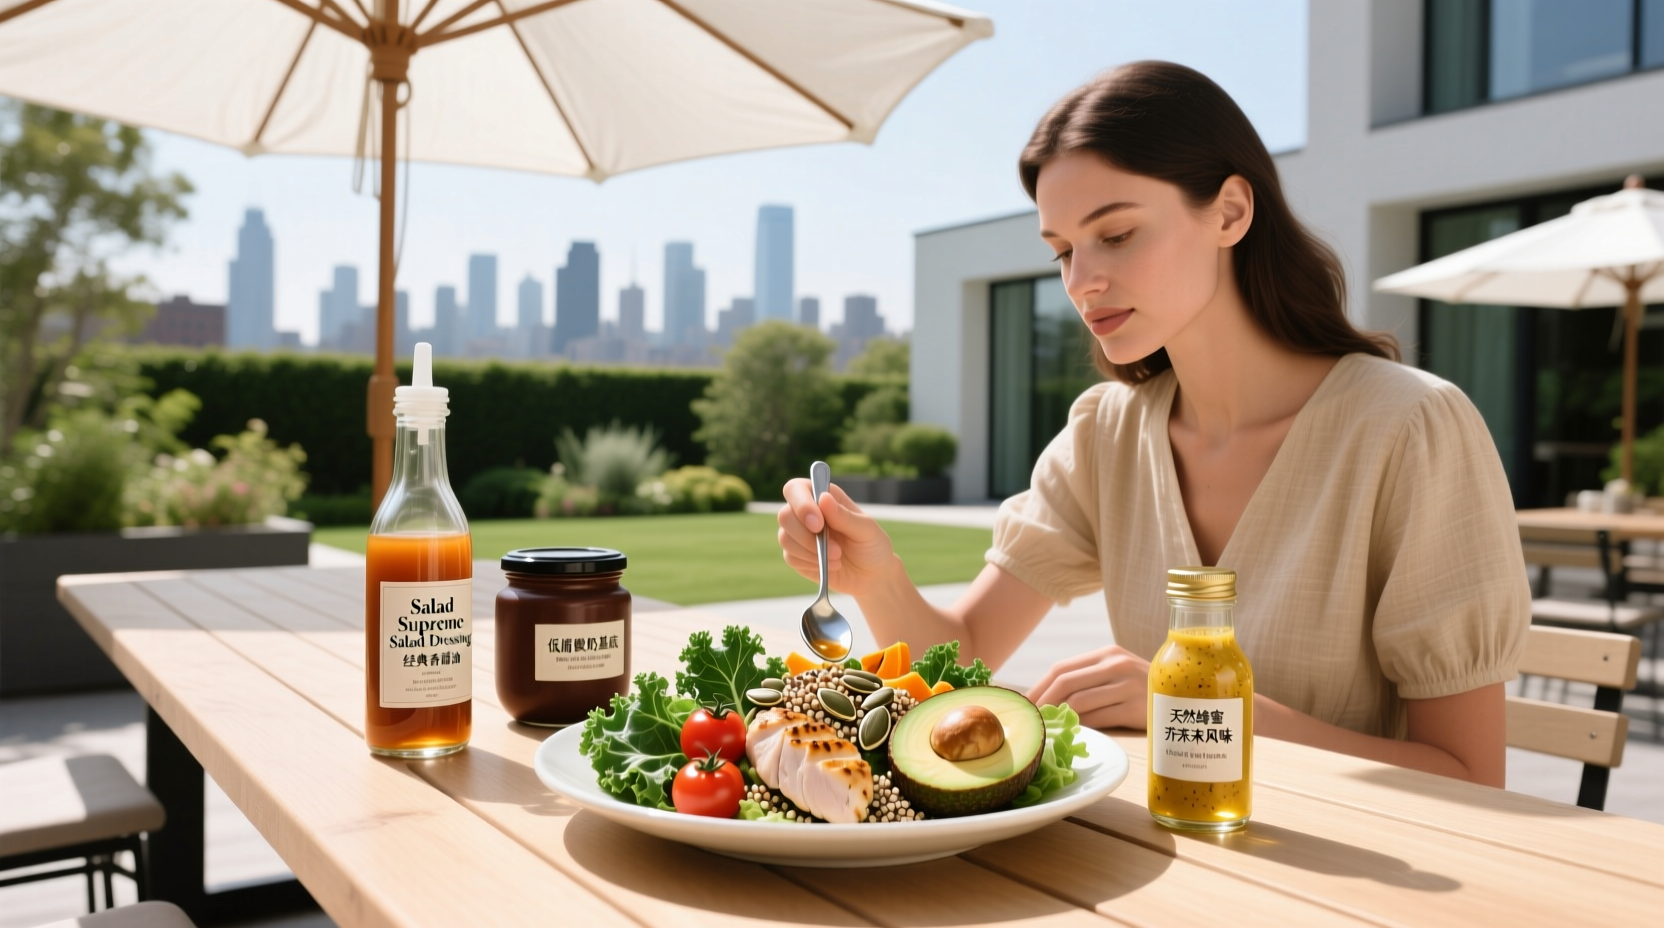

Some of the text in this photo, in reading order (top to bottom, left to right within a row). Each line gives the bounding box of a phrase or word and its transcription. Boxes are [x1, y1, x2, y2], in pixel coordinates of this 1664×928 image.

[410, 597, 454, 615] Salad
[398, 616, 464, 635] Supreme
[389, 635, 425, 649] Salad
[1170, 708, 1224, 725] 天然蜂蜜
